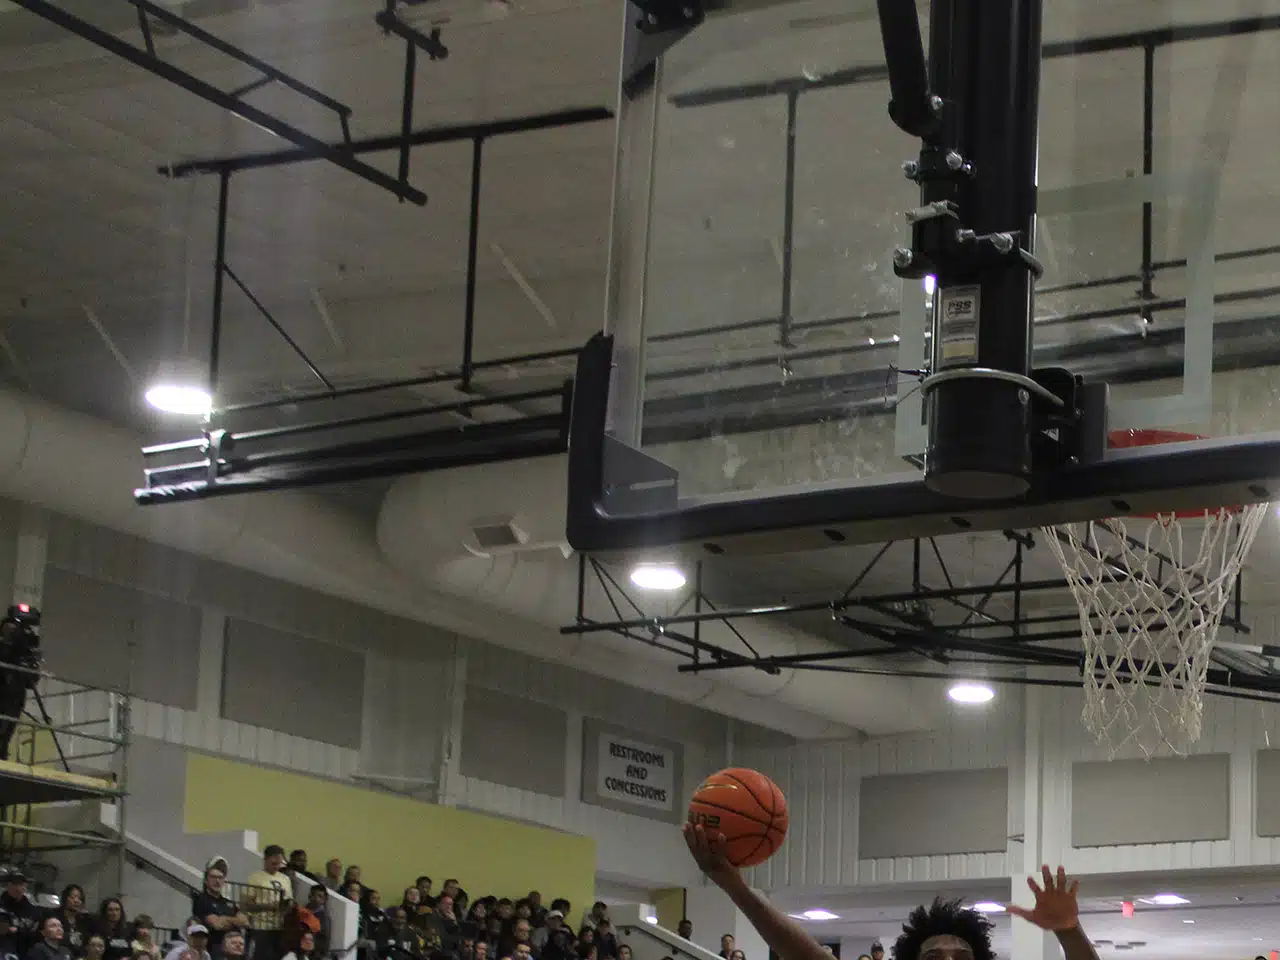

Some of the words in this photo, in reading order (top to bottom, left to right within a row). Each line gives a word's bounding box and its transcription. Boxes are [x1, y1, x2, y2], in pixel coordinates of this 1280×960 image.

[609, 742, 665, 768] RESTROOMS
[626, 764, 648, 780] AND
[605, 776, 667, 802] CONCESSIONS
